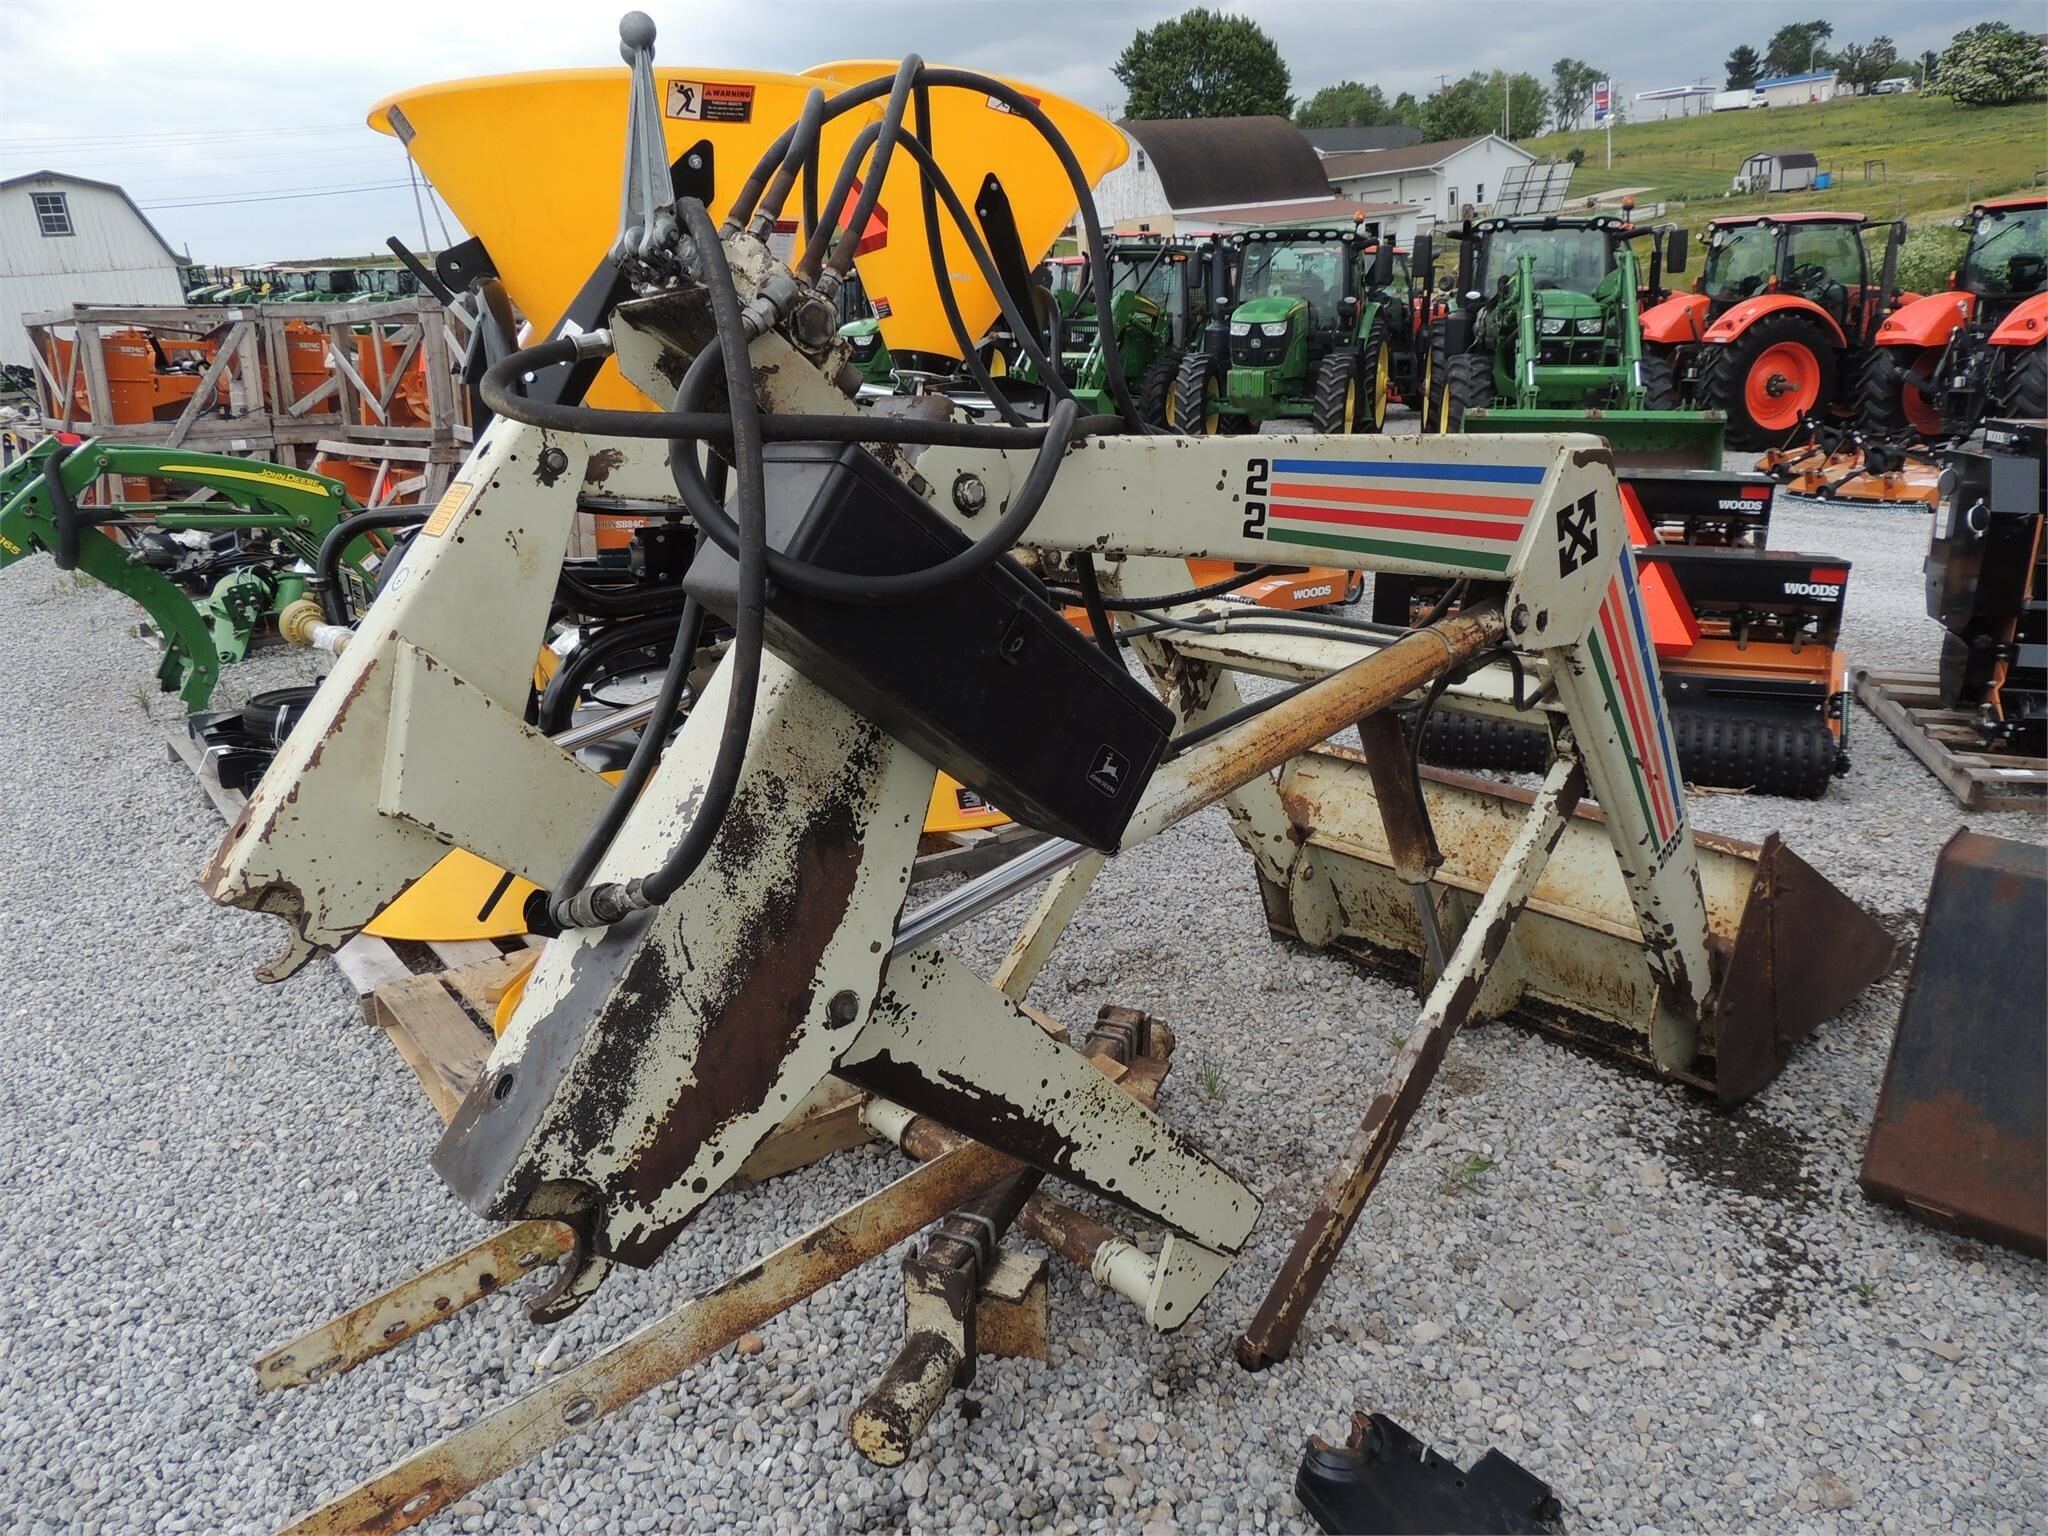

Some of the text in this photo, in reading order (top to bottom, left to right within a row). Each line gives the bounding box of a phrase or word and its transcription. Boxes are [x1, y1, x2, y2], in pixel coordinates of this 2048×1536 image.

[712, 89, 750, 98] WARNING
[257, 469, 321, 487] JOHN DEERE
[1718, 500, 1762, 510] WOODS
[1293, 585, 1332, 600] WOODS
[1783, 582, 1840, 597] WOODS
